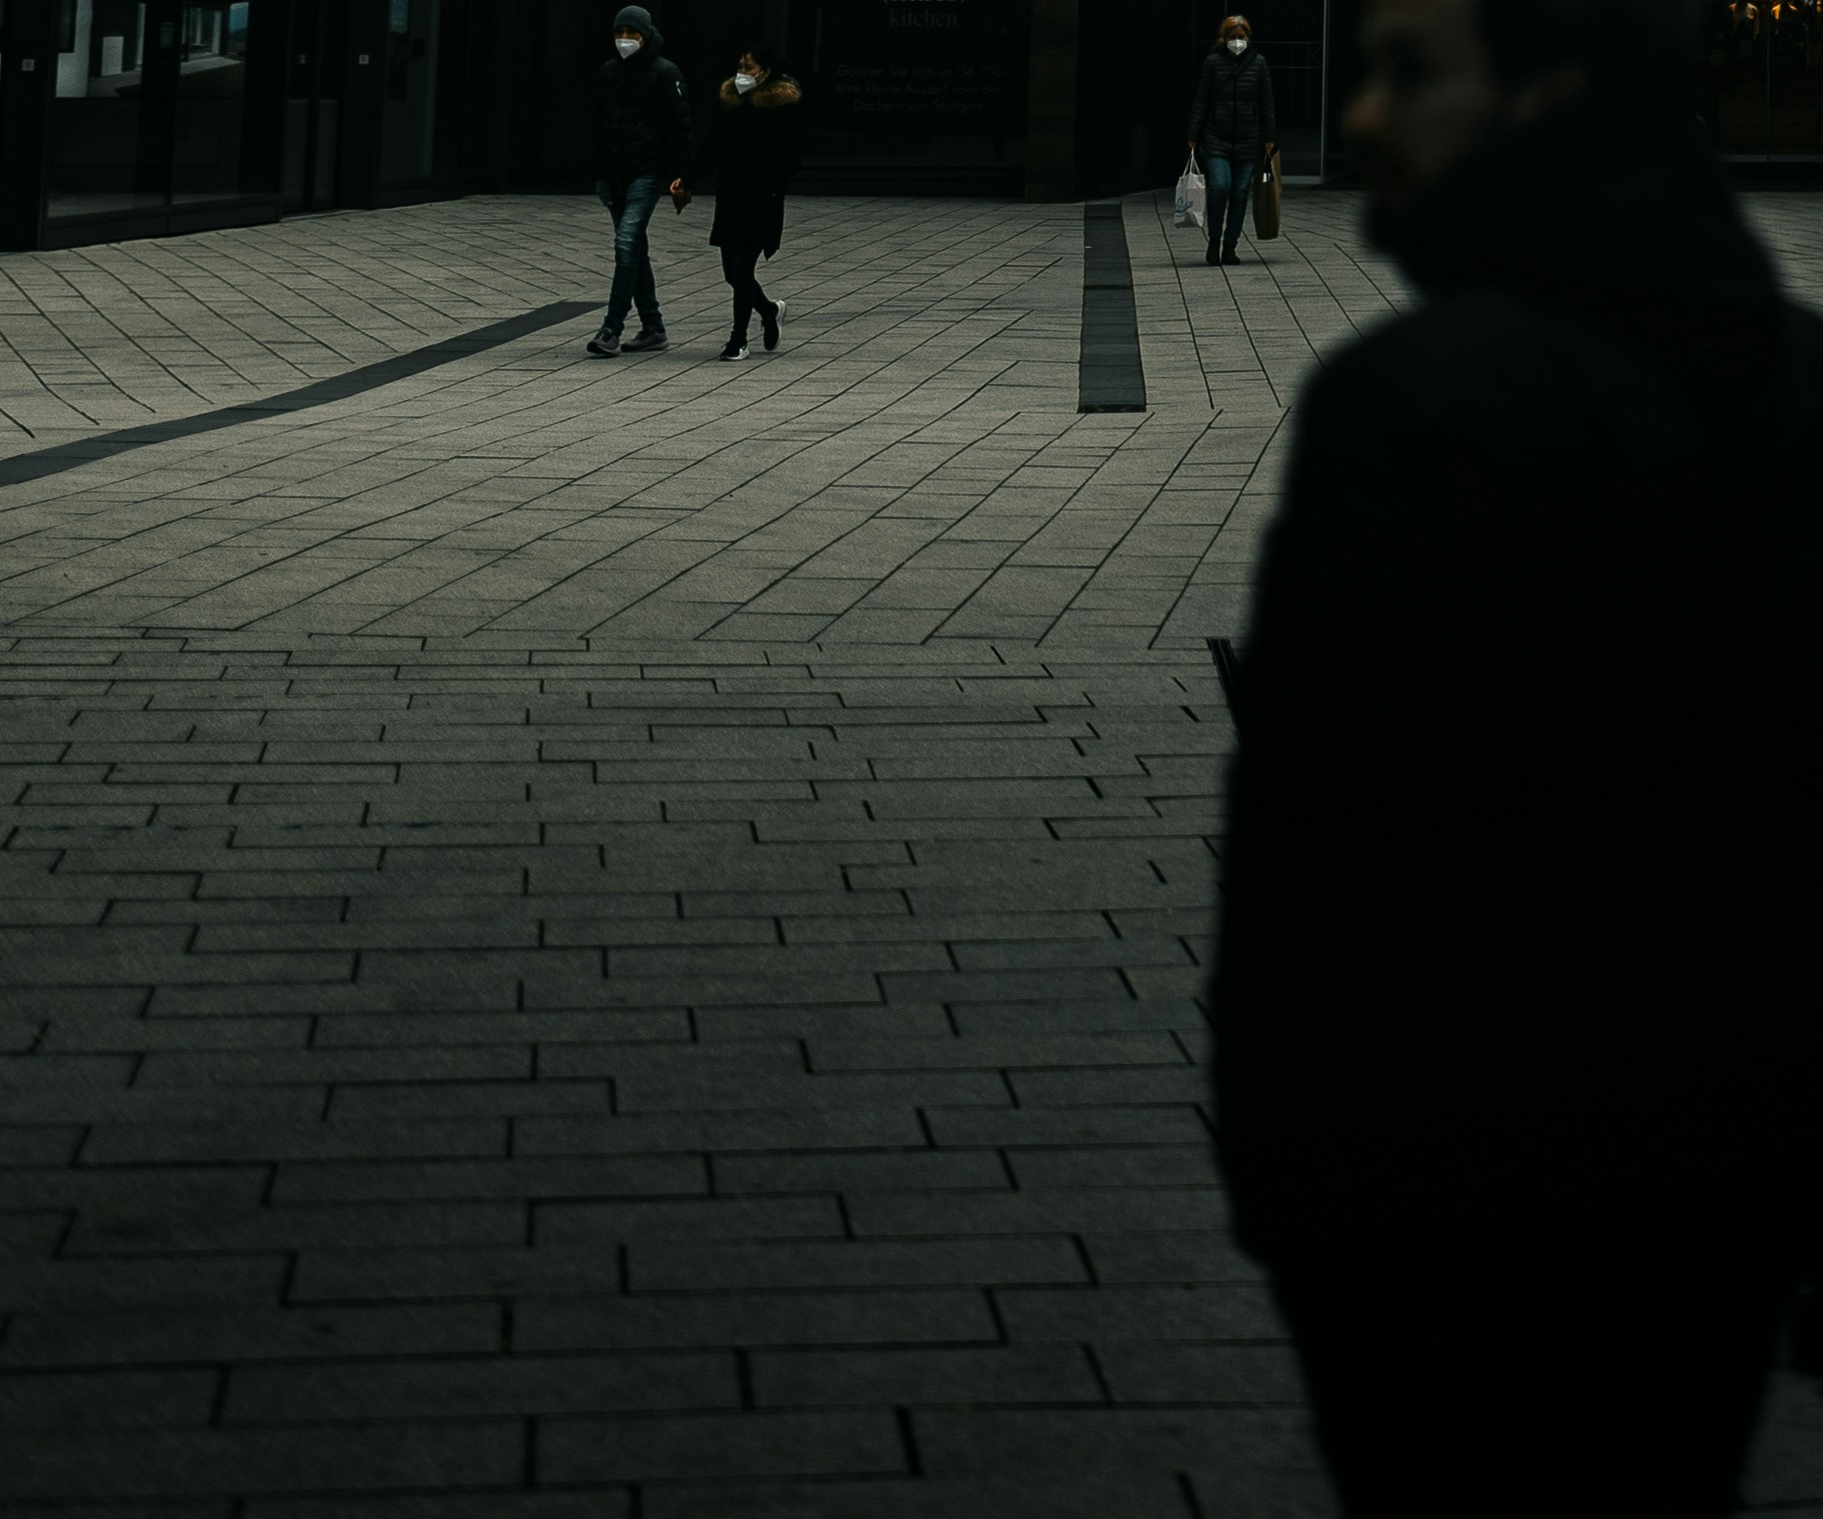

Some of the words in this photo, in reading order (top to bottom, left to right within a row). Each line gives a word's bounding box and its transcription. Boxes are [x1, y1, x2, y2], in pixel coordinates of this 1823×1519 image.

[889, 8, 958, 28] kitchen
[836, 65, 884, 78] Gönnen
[889, 65, 908, 78] Sie
[912, 65, 935, 78] sich
[938, 66, 953, 78] im
[982, 65, 1006, 78] OG
[836, 82, 862, 95] eine
[866, 81, 901, 95] kleine
[904, 82, 948, 95] Auszeit
[982, 82, 1004, 95] den
[853, 99, 904, 112] Dachern
[908, 102, 928, 112] von
